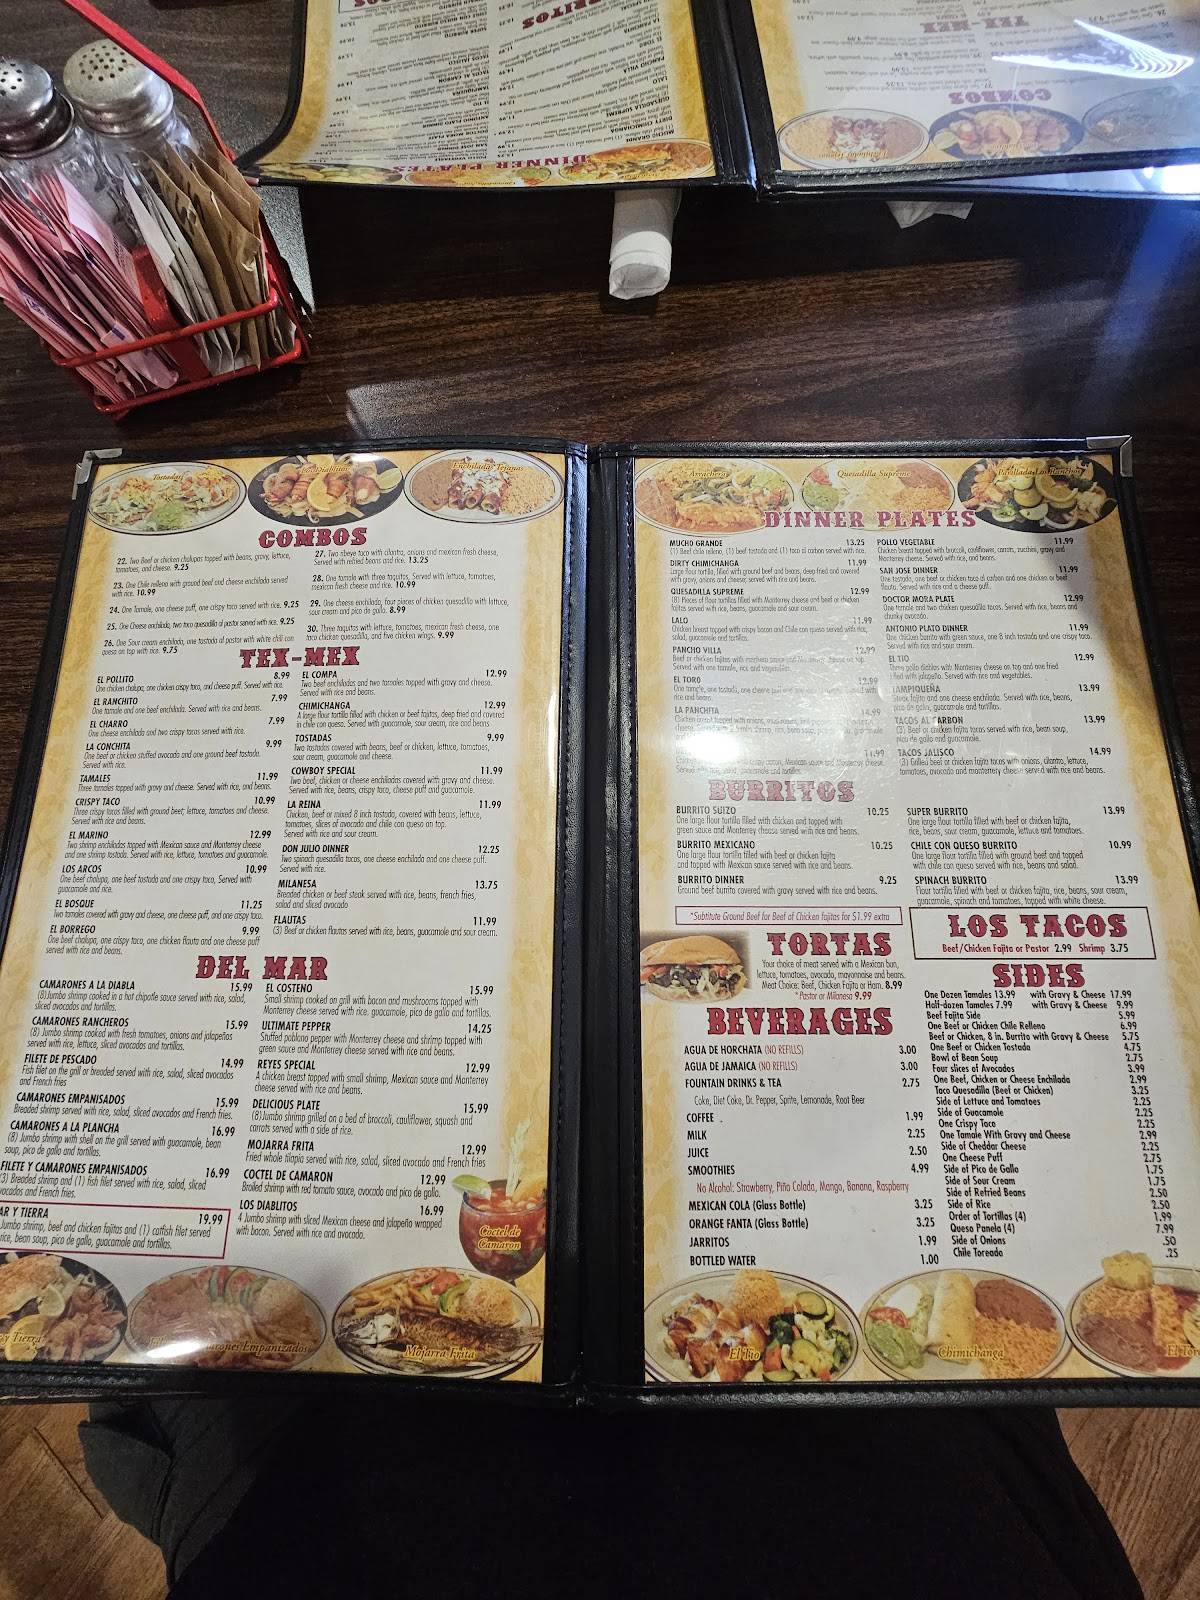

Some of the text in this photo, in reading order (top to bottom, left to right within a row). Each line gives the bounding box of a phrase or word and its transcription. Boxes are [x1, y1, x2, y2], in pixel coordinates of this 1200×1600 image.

[919, 15, 1029, 34] TEX-MEX
[948, 89, 1053, 104] COMBOS
[392, 154, 587, 172] DINNER PLATES
[837, 468, 911, 479] Quesadilla Supreme
[765, 511, 976, 528] DINNER PLATES
[258, 527, 368, 549] COMBOS
[669, 539, 694, 547] MUCHO
[846, 538, 865, 546] 13.25
[670, 559, 690, 567] DIRTY
[885, 623, 1089, 632] ANTONIO PLATO DINNER 11.99
[239, 646, 360, 669] TEX-MEX
[97, 671, 290, 684] EL POLLITO 8.99
[301, 669, 507, 679] EL COMPA 12.99
[298, 701, 506, 711] CHIMICHANGA 12.99
[89, 716, 285, 728] EL CHARRO 7.99
[897, 747, 1111, 757] TACOS JALISCO 14.99
[291, 766, 503, 775] COWBOY SPECIAL 11.99
[709, 779, 855, 803] BURRITOS
[75, 796, 276, 806] CRISPY TACO 10.99
[287, 800, 502, 809] LA REINA 11.99
[906, 806, 1125, 816] SUPER BURRITO 13.99
[282, 844, 500, 854] DON JULIO DINNER 12.25
[677, 840, 893, 850] BURRITO MEXICANO 10.25
[278, 879, 498, 890] MILANESA 13.75
[55, 899, 263, 909] EL BOSQUE 11.25
[947, 913, 1127, 938] LOS TACOS
[766, 932, 892, 957] TORTAS
[942, 943, 992, 954] Beef/Chicken
[992, 943, 1014, 955] Fajita
[1025, 943, 1049, 953] Pastor
[1054, 943, 1072, 953] 2.99
[1078, 943, 1106, 955] Shrimp
[1110, 943, 1129, 953] 3.75
[195, 955, 328, 981] DEL MAR
[992, 963, 1085, 988] SIDES
[924, 989, 1016, 999] One Dozen Tamales 13.99
[32, 1016, 249, 1030] CAMARONES RANCHEROS 15.99
[262, 1020, 492, 1034] ULTIMATE PEPPER 14.25
[706, 1007, 893, 1036] BEVERAGES
[24, 1053, 244, 1069] FILETE DE PESCADO 14.99
[932, 1063, 1145, 1073] Four slices of Avocados 3.99
[685, 1077, 920, 1088] FOUNTAIN DRINKS & TEA 2.75
[686, 1111, 924, 1123] COFFEE 1.99
[937, 1107, 1153, 1117] Side of Guacamole 2.25
[247, 1139, 487, 1155] MOJARRA FRITA 12.99
[243, 1169, 446, 1185] COCTEL DE CAMARON 12.99
[696, 1180, 909, 1194] No Alcohol: Strawberry, Piña Colada, Mango, Banana, Raspberry
[239, 1199, 444, 1216] LOS DIABLITOS 16.99
[688, 1198, 933, 1212] MEXICAN COLA (Glass Bottle) 3.25
[478, 1225, 522, 1238] Coctel de
[477, 1238, 522, 1251] Camaron
[403, 1345, 477, 1360] Mojarra Frita
[937, 1345, 1005, 1361] Chimichanga
